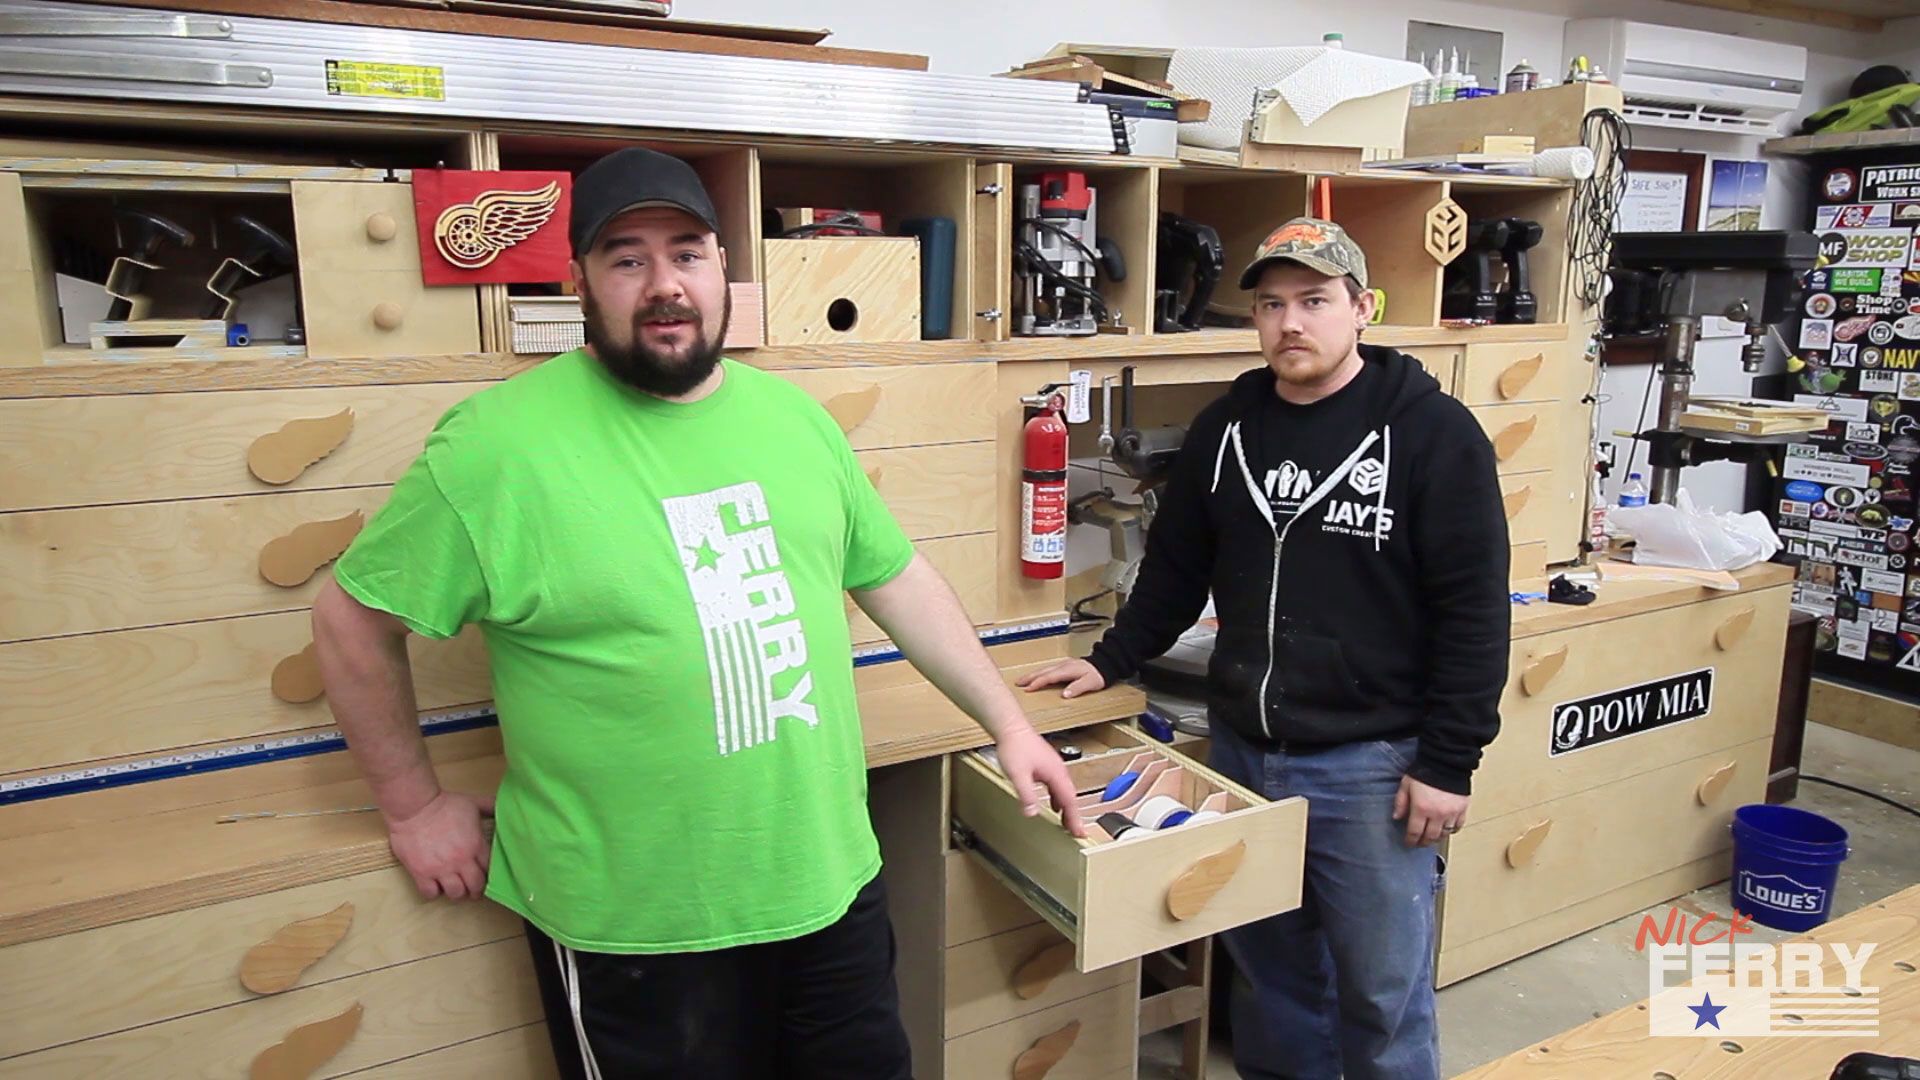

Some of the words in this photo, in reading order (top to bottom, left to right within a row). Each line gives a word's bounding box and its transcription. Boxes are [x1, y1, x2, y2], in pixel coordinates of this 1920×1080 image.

[1820, 241, 1844, 256] MF
[1846, 235, 1908, 249] WOOD
[1846, 249, 1903, 262] SHOP
[1857, 294, 1892, 306] Shop
[1856, 304, 1891, 314] Time
[1883, 348, 1920, 369] NAV
[1323, 500, 1395, 532] JAY'S
[1321, 525, 1350, 534] CUSTOM
[1861, 528, 1885, 540] WP
[717, 481, 820, 728] FERRY
[1587, 691, 1650, 738] POW
[1657, 679, 1705, 720] MIA
[1745, 878, 1818, 910] LOWE'S
